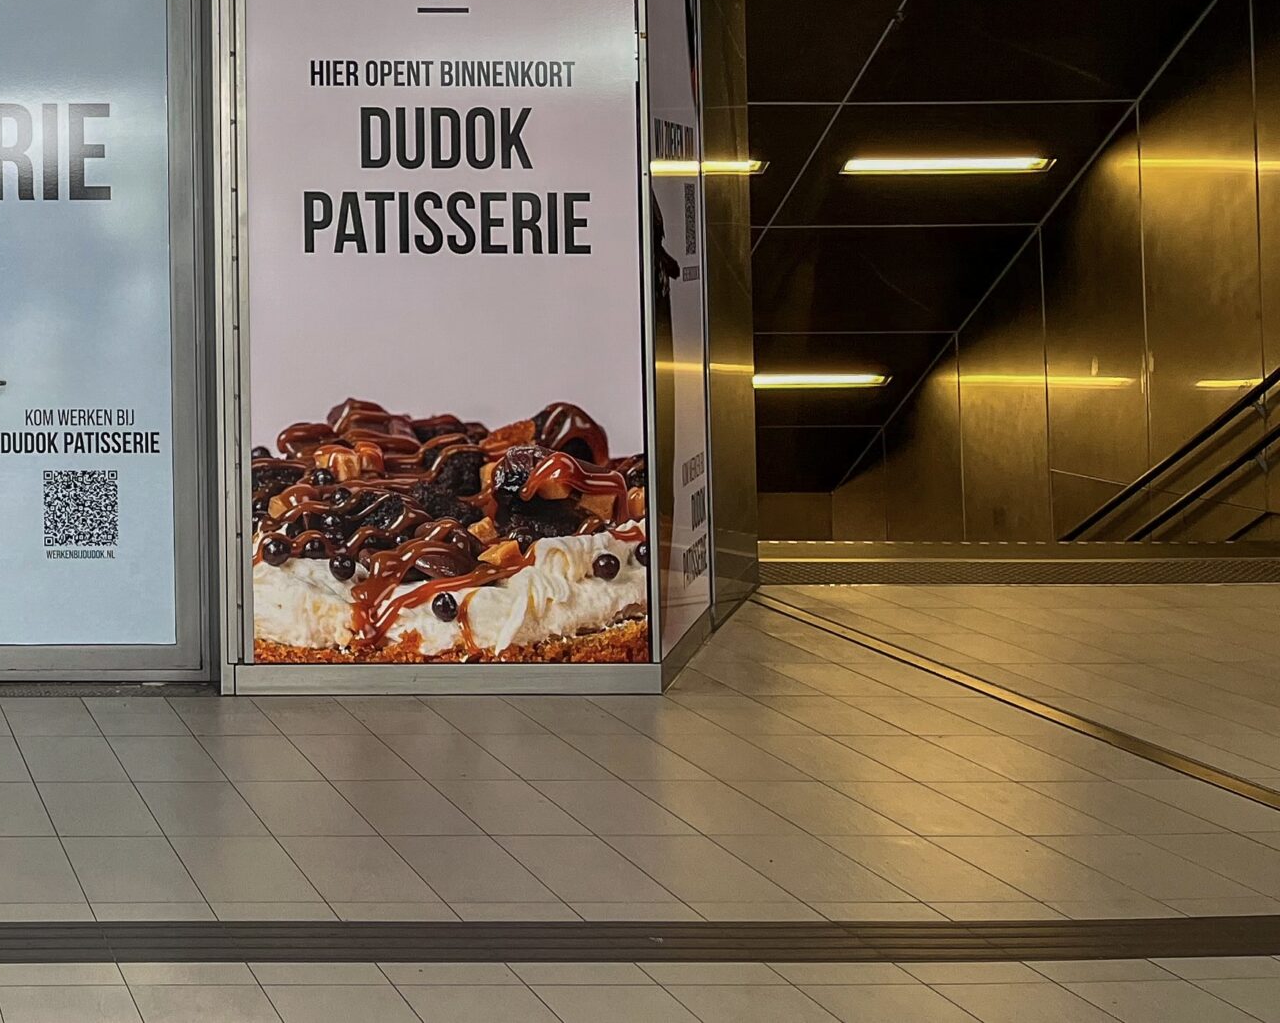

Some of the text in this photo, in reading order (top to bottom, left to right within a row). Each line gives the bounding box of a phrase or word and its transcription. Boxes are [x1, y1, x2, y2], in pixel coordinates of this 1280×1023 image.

[310, 60, 576, 88] HIER OPENT BINNENKORT
[360, 106, 534, 170] DUDOK
[303, 190, 592, 255] PATISSERIE
[25, 408, 135, 426] KOM WERKEN BIJ
[0, 431, 161, 454] DUDOK PATISSERIE
[46, 549, 116, 560] WERKENBIJDUDOK.NL
